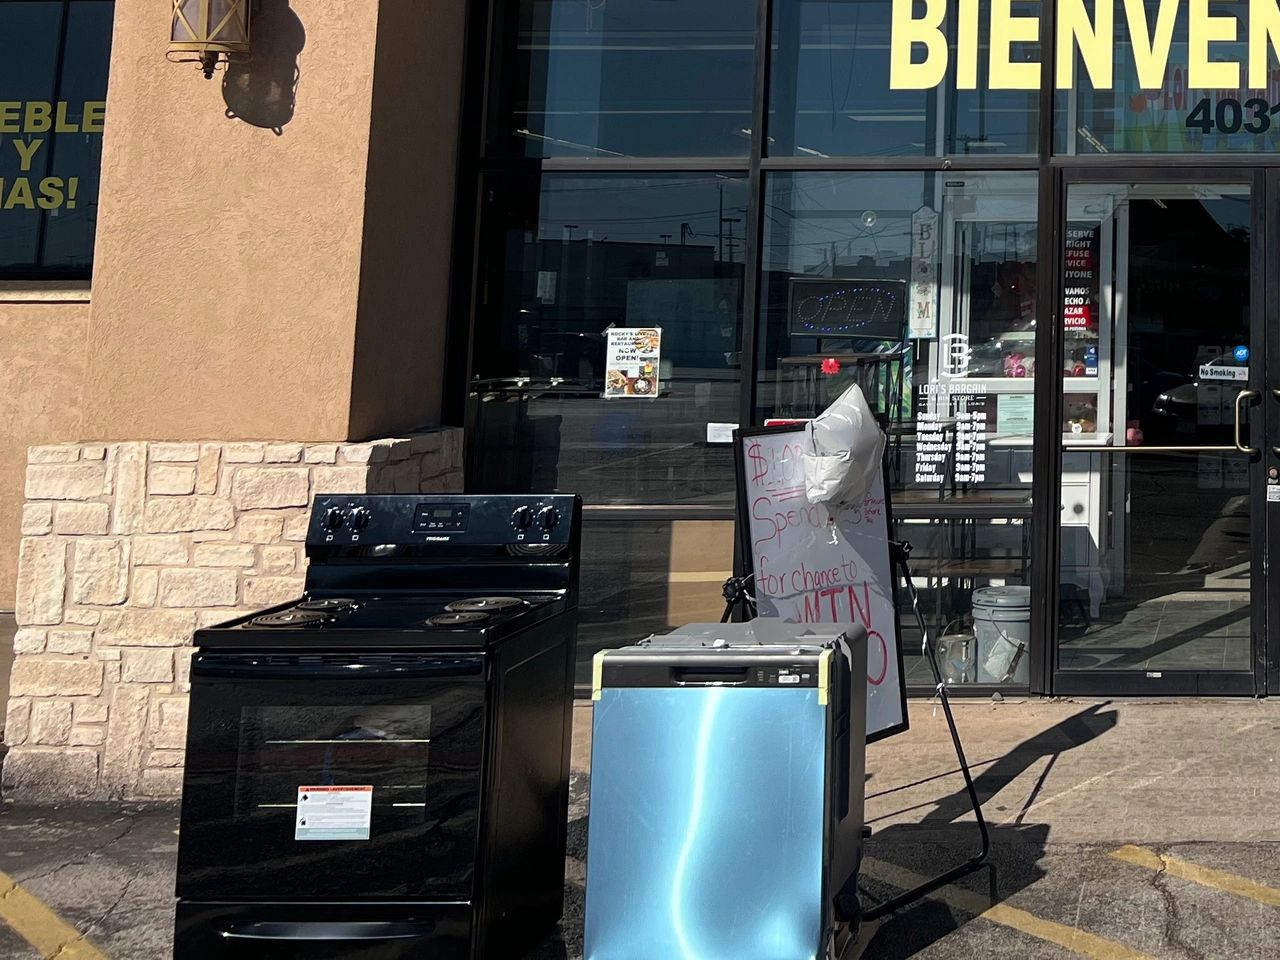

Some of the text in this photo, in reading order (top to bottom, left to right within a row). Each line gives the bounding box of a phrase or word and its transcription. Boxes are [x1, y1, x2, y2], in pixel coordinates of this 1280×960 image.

[12, 139, 44, 171] Y
[797, 295, 896, 323] OPEN
[1210, 368, 1236, 378] Smoking
[919, 383, 987, 394] LORI'S BARGAIN
[917, 412, 940, 421] Sunday
[917, 422, 942, 432] Monday
[917, 432, 944, 442] Tuesday
[916, 442, 952, 452] Wednesday
[916, 452, 946, 463] Thursday
[916, 463, 936, 473] Friday
[915, 473, 944, 483] Saturday
[757, 554, 857, 597] for chance to
